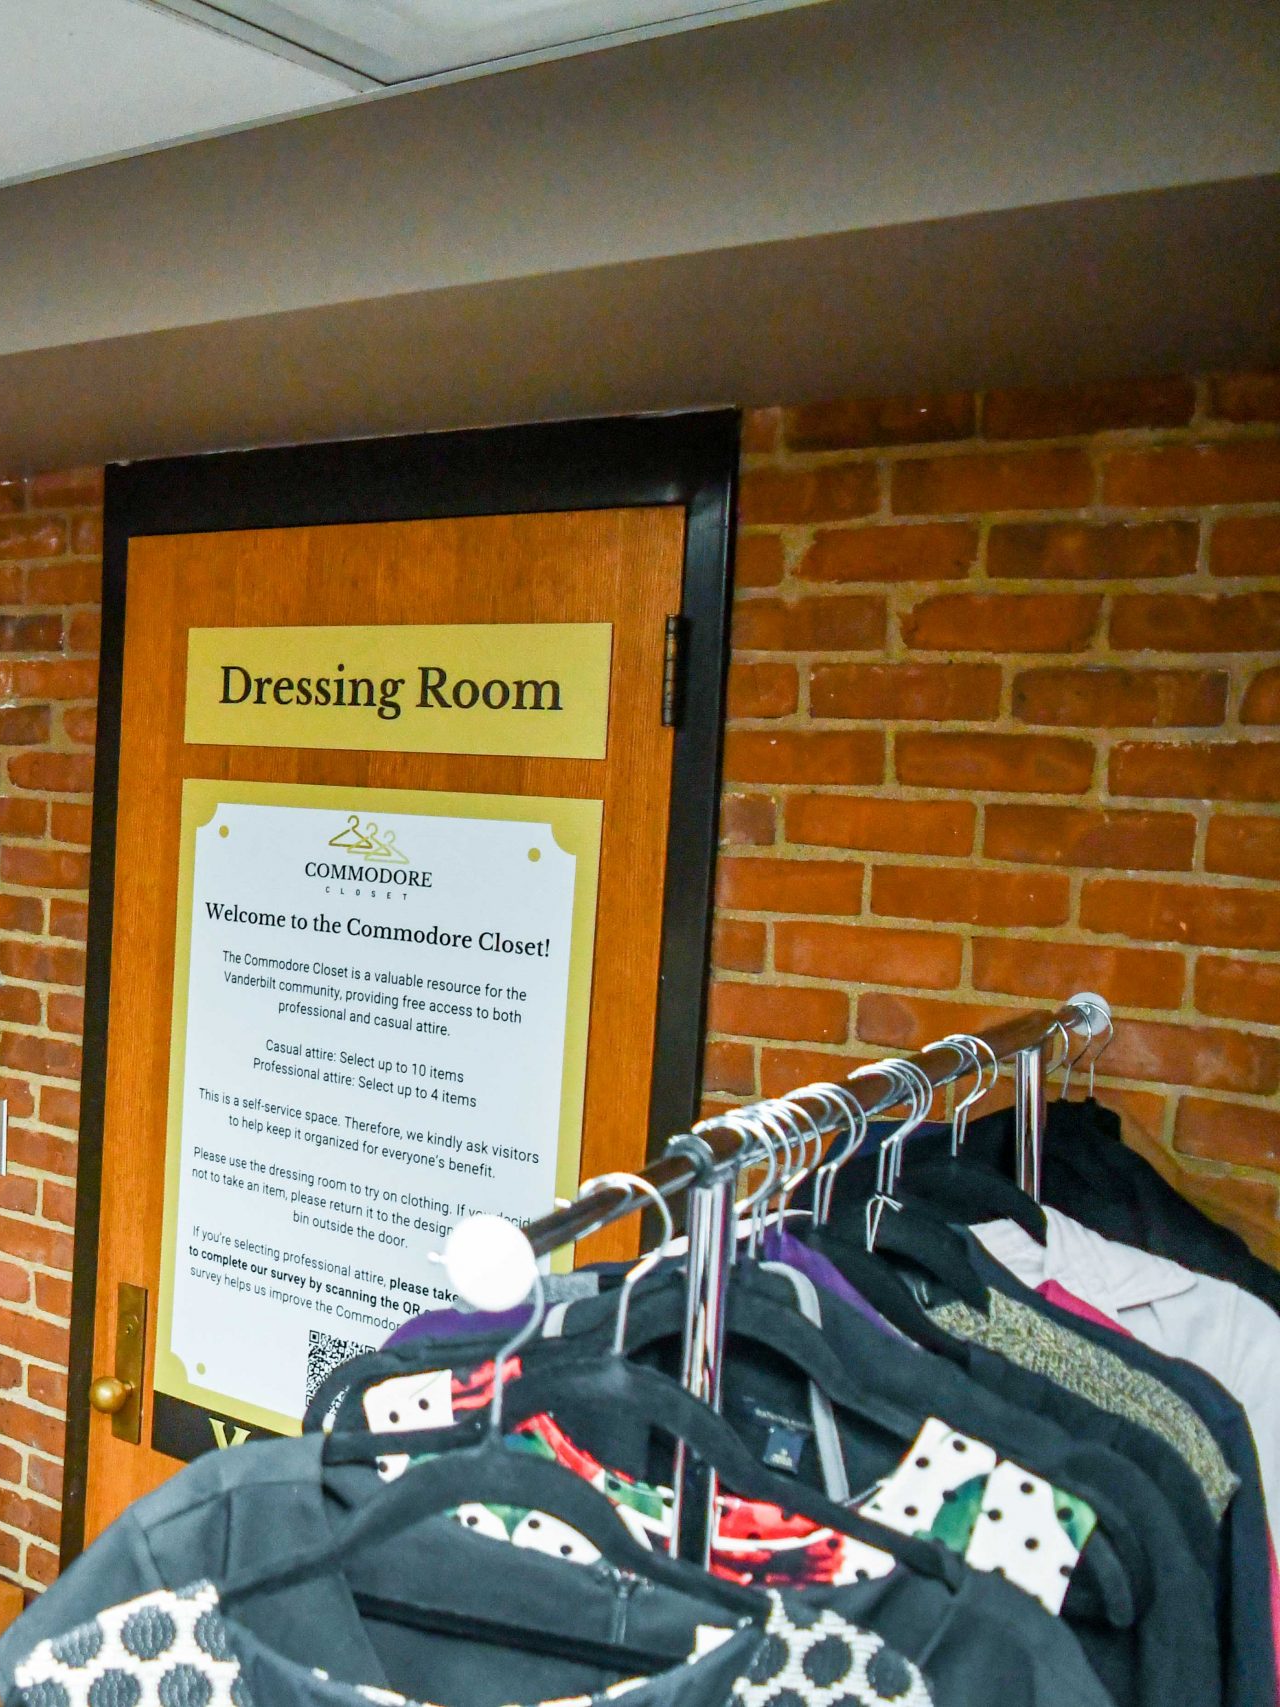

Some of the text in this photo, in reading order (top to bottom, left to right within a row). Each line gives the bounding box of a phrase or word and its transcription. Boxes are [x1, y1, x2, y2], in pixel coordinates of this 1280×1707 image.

[219, 663, 563, 720] Dressing Room
[304, 861, 432, 888] COMMODORE
[204, 901, 550, 958] Welcome to the Commodore Closet!
[222, 949, 527, 1002] The Commodore Closet is a valuable resource for the
[223, 970, 522, 1024] Vanderbilt community, providing free access to both
[278, 1000, 450, 1036] professional and casual attire.
[253, 1057, 477, 1108] Professional attire: Select up to 4 items
[265, 1038, 464, 1083] Casual attire: Select up to 10 items
[198, 1087, 539, 1164] This is a self-service space. Therefore, we kindly ask visitors
[228, 1114, 495, 1178] to help keep it organized for everyone's benefit.
[191, 1168, 208, 1180] not
[209, 1170, 220, 1183] to
[222, 1173, 244, 1189] take
[246, 1181, 259, 1192] an
[262, 1182, 287, 1200] item,
[290, 1189, 327, 1208] please
[329, 1200, 363, 1216] return
[365, 1205, 374, 1219] it
[376, 1208, 388, 1222] to
[391, 1211, 410, 1227] the
[193, 1145, 227, 1164] Please
[228, 1156, 247, 1169] use
[249, 1159, 266, 1174] the
[268, 1163, 314, 1188] dressing
[317, 1176, 347, 1192] room
[349, 1181, 361, 1195] to
[364, 1184, 380, 1202] try
[382, 1190, 397, 1203] on
[400, 1192, 452, 1216] clothing.
[456, 1203, 466, 1217] If
[292, 1209, 408, 1248] bin outside the door.
[188, 1244, 420, 1315] to complete our survey by scanning the QR
[192, 1225, 200, 1237] If
[201, 1230, 231, 1246] you're
[233, 1238, 280, 1262] selecting
[282, 1251, 351, 1277] professional
[353, 1269, 386, 1288] attire,
[389, 1276, 429, 1297] please
[190, 1266, 400, 1331] survey helps us improve the Commodor
